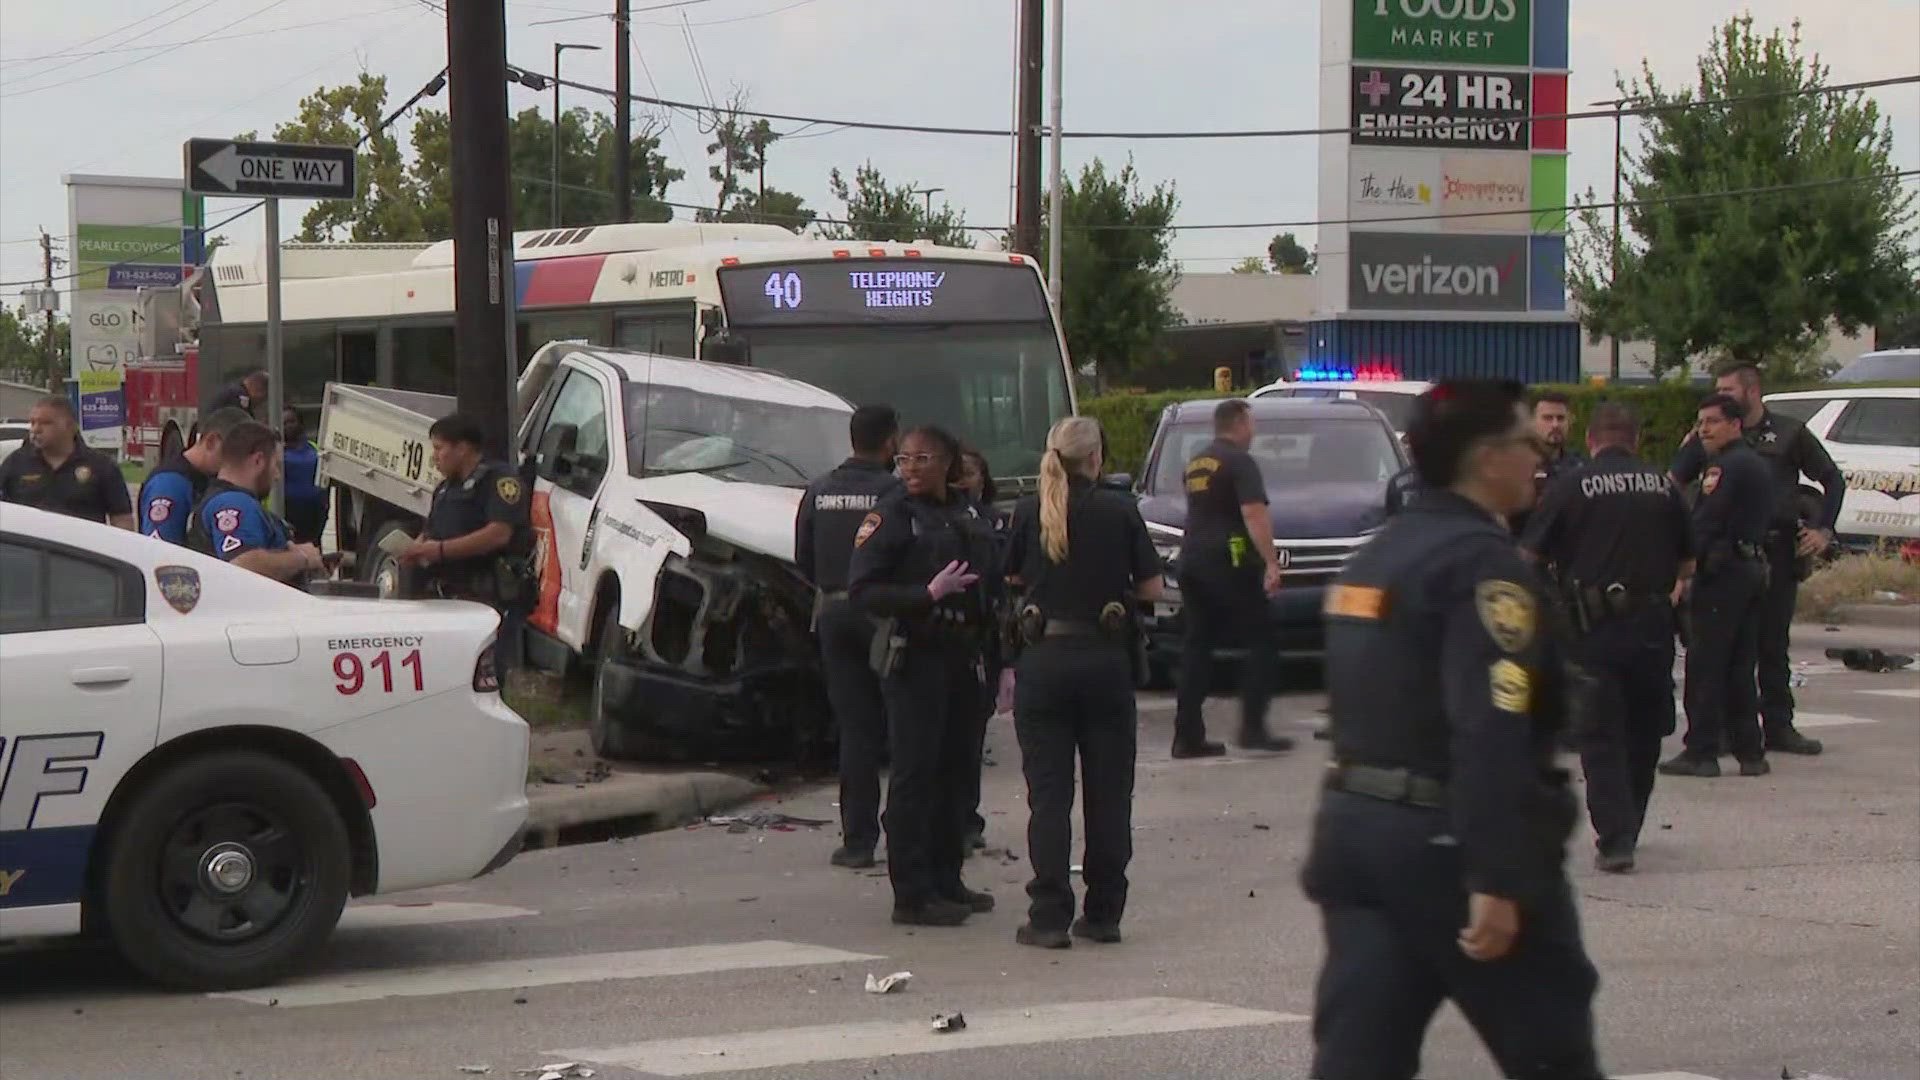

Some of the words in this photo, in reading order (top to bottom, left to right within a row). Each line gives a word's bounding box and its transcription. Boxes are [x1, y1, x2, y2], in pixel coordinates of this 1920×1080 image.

[1391, 28, 1495, 48] MARKET
[1399, 73, 1447, 107] 24
[1456, 75, 1523, 110] HR.
[1359, 114, 1523, 141] EMERGENCY
[240, 158, 284, 180] ONE
[293, 159, 337, 182] WAY
[1360, 172, 1380, 198] The
[1388, 175, 1415, 199] Hive
[80, 240, 120, 251] PEARLE
[650, 270, 684, 288] METRO
[850, 272, 945, 289] TELEPHONE/
[1361, 255, 1499, 295] verizon
[764, 272, 801, 309] 40
[865, 291, 932, 307] HEIGHTS
[89, 313, 121, 327] GLO
[333, 432, 349, 451] RENT
[360, 441, 389, 468] STARTING
[390, 454, 400, 471] AT
[402, 439, 423, 480] $19
[328, 636, 423, 650] EMERGENCY
[333, 650, 424, 695] 911
